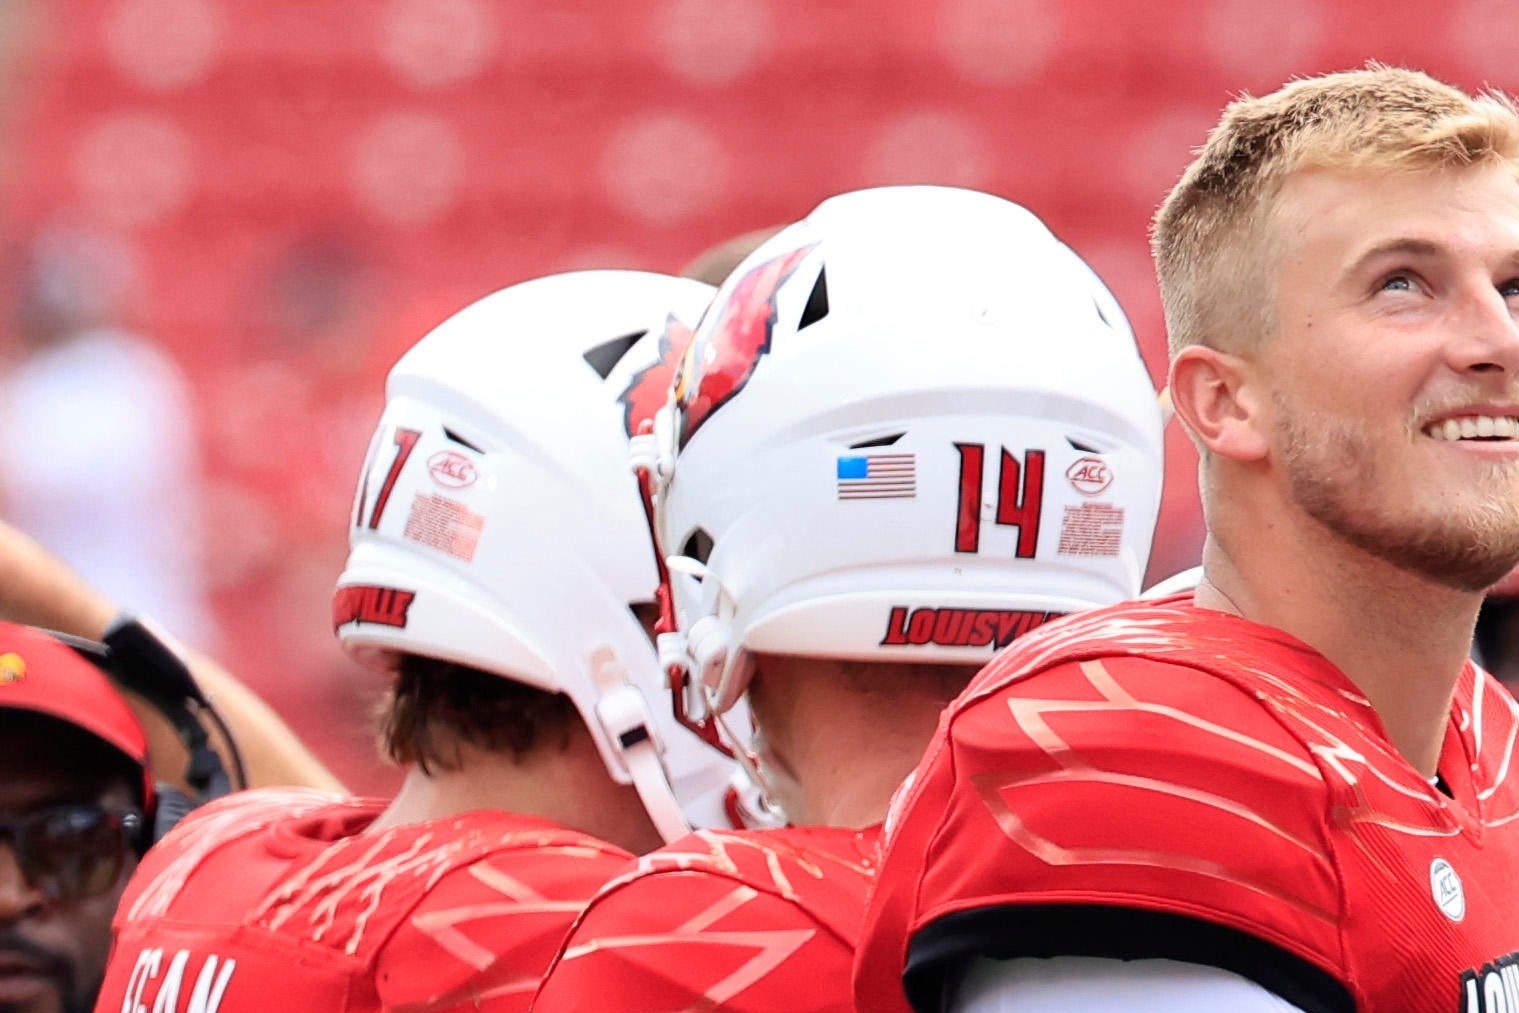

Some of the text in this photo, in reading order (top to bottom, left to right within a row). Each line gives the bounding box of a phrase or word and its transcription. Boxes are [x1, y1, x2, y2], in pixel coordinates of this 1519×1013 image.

[430, 458, 474, 481] ACC
[1073, 466, 1109, 484] ACC
[952, 442, 1046, 559] 14
